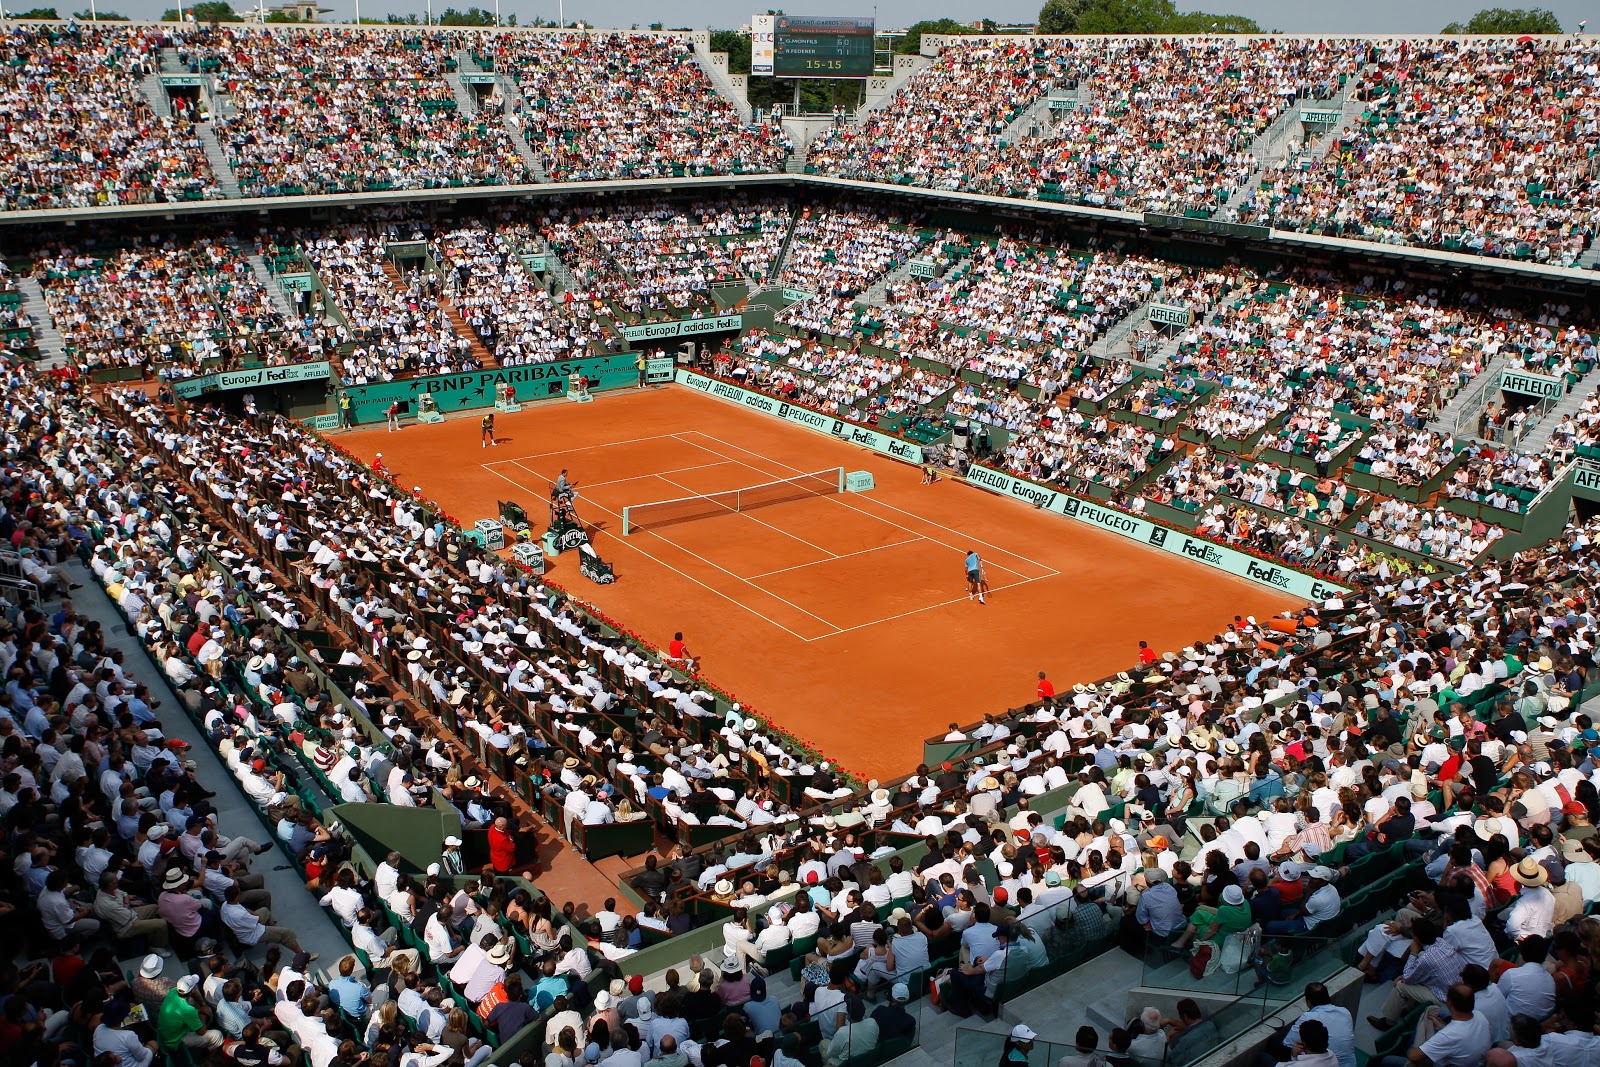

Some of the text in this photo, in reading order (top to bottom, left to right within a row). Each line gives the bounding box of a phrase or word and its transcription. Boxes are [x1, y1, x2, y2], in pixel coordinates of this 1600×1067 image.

[806, 60, 842, 69] 15-15
[1150, 308, 1189, 324] AFFLELOU
[684, 322, 714, 332] adidas
[717, 318, 740, 329] FedEx
[200, 375, 217, 386] IBM
[267, 369, 299, 381] FedEx
[304, 370, 329, 378] AFFLELOU
[426, 363, 572, 394] BNP PARIBAS
[1502, 376, 1563, 397] AFFLELOU
[372, 395, 403, 405] PARIBAS
[713, 384, 744, 401] AFFLELOU
[746, 395, 773, 411] adidas
[788, 408, 915, 459] PEUGEOT FedEx FedEx
[858, 478, 871, 487] IBM
[968, 468, 1010, 490] AFFLELOU
[1080, 505, 1140, 534] PEUGEOT
[1182, 539, 1223, 565] FedEx
[1246, 560, 1291, 589] FedEx
